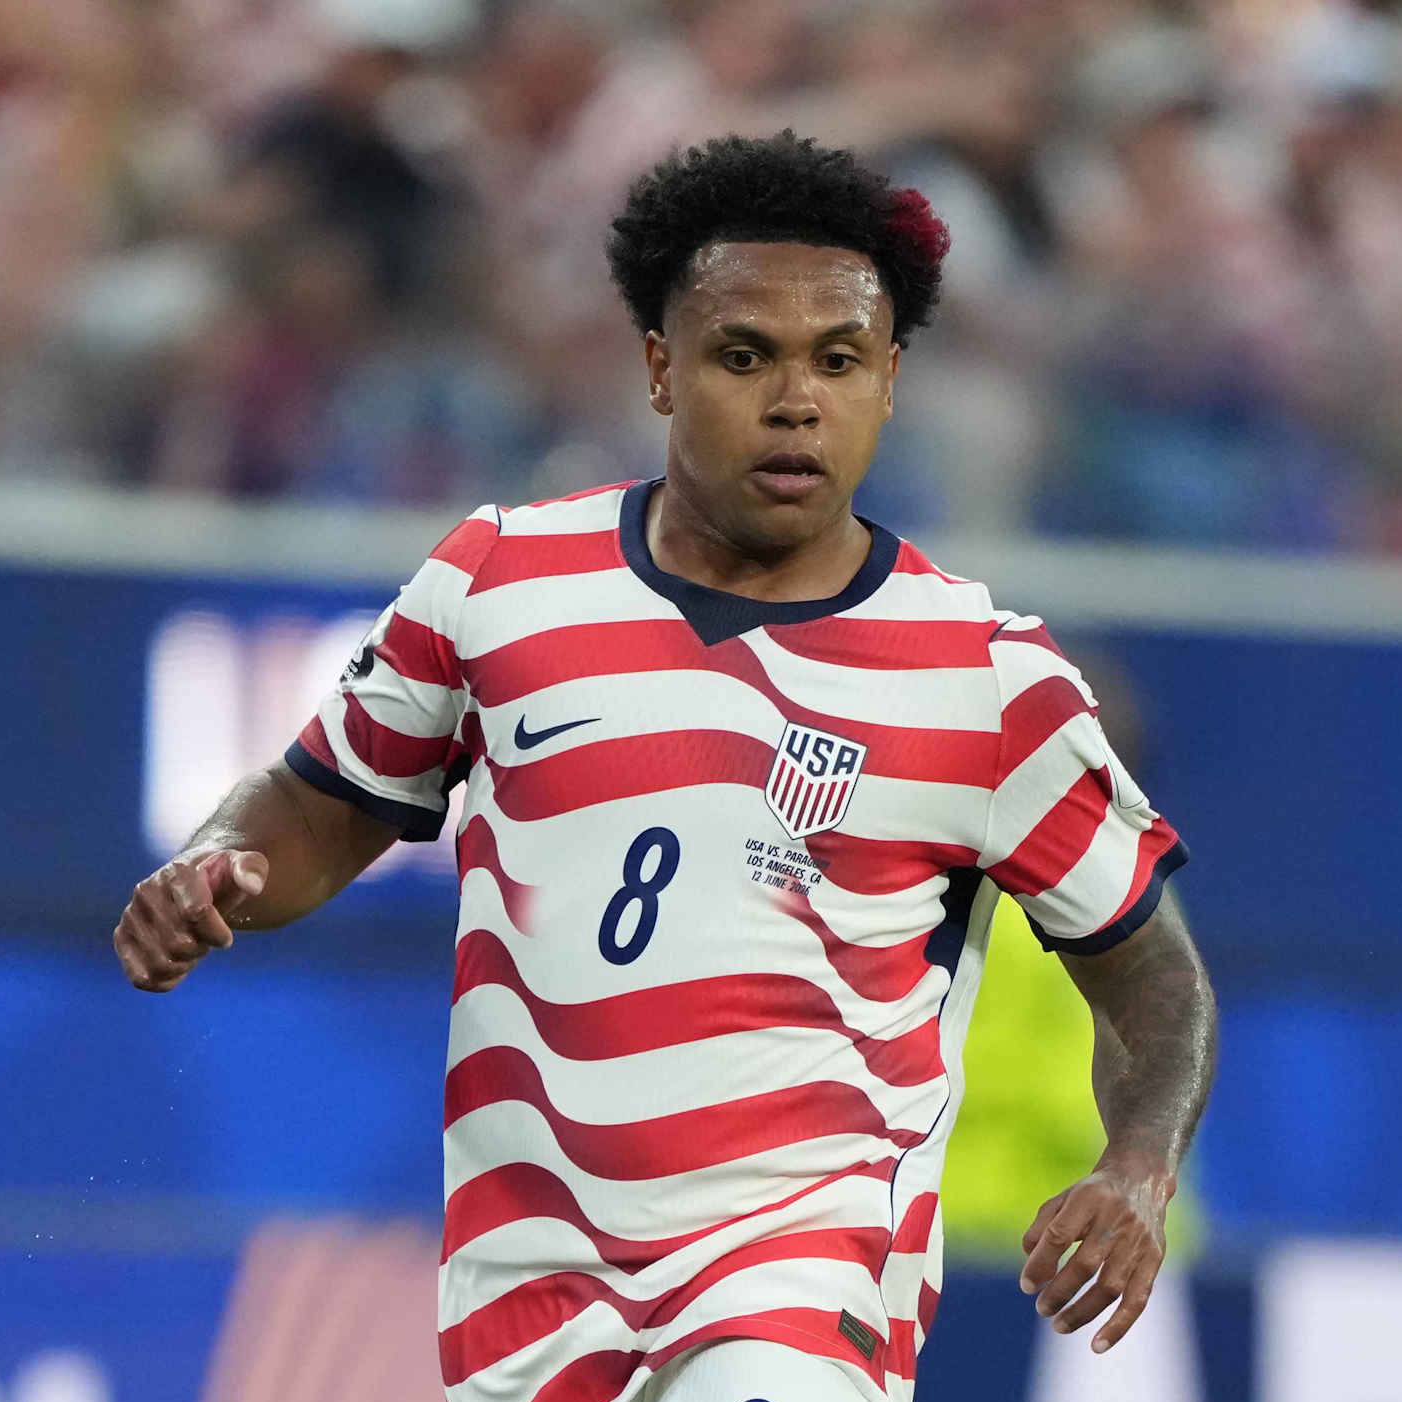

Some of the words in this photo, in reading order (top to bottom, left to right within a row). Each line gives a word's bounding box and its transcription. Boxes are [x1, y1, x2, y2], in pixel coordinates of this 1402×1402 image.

[786, 729, 859, 777] USA
[745, 838, 765, 853] USA
[767, 844, 781, 858] VS.
[783, 849, 831, 871] PARAG
[746, 854, 765, 868] LOS
[765, 860, 806, 882] ANGELES,
[810, 872, 823, 885] CA
[598, 826, 681, 966] 8
[751, 870, 763, 882] 12
[764, 874, 788, 889] JUNE
